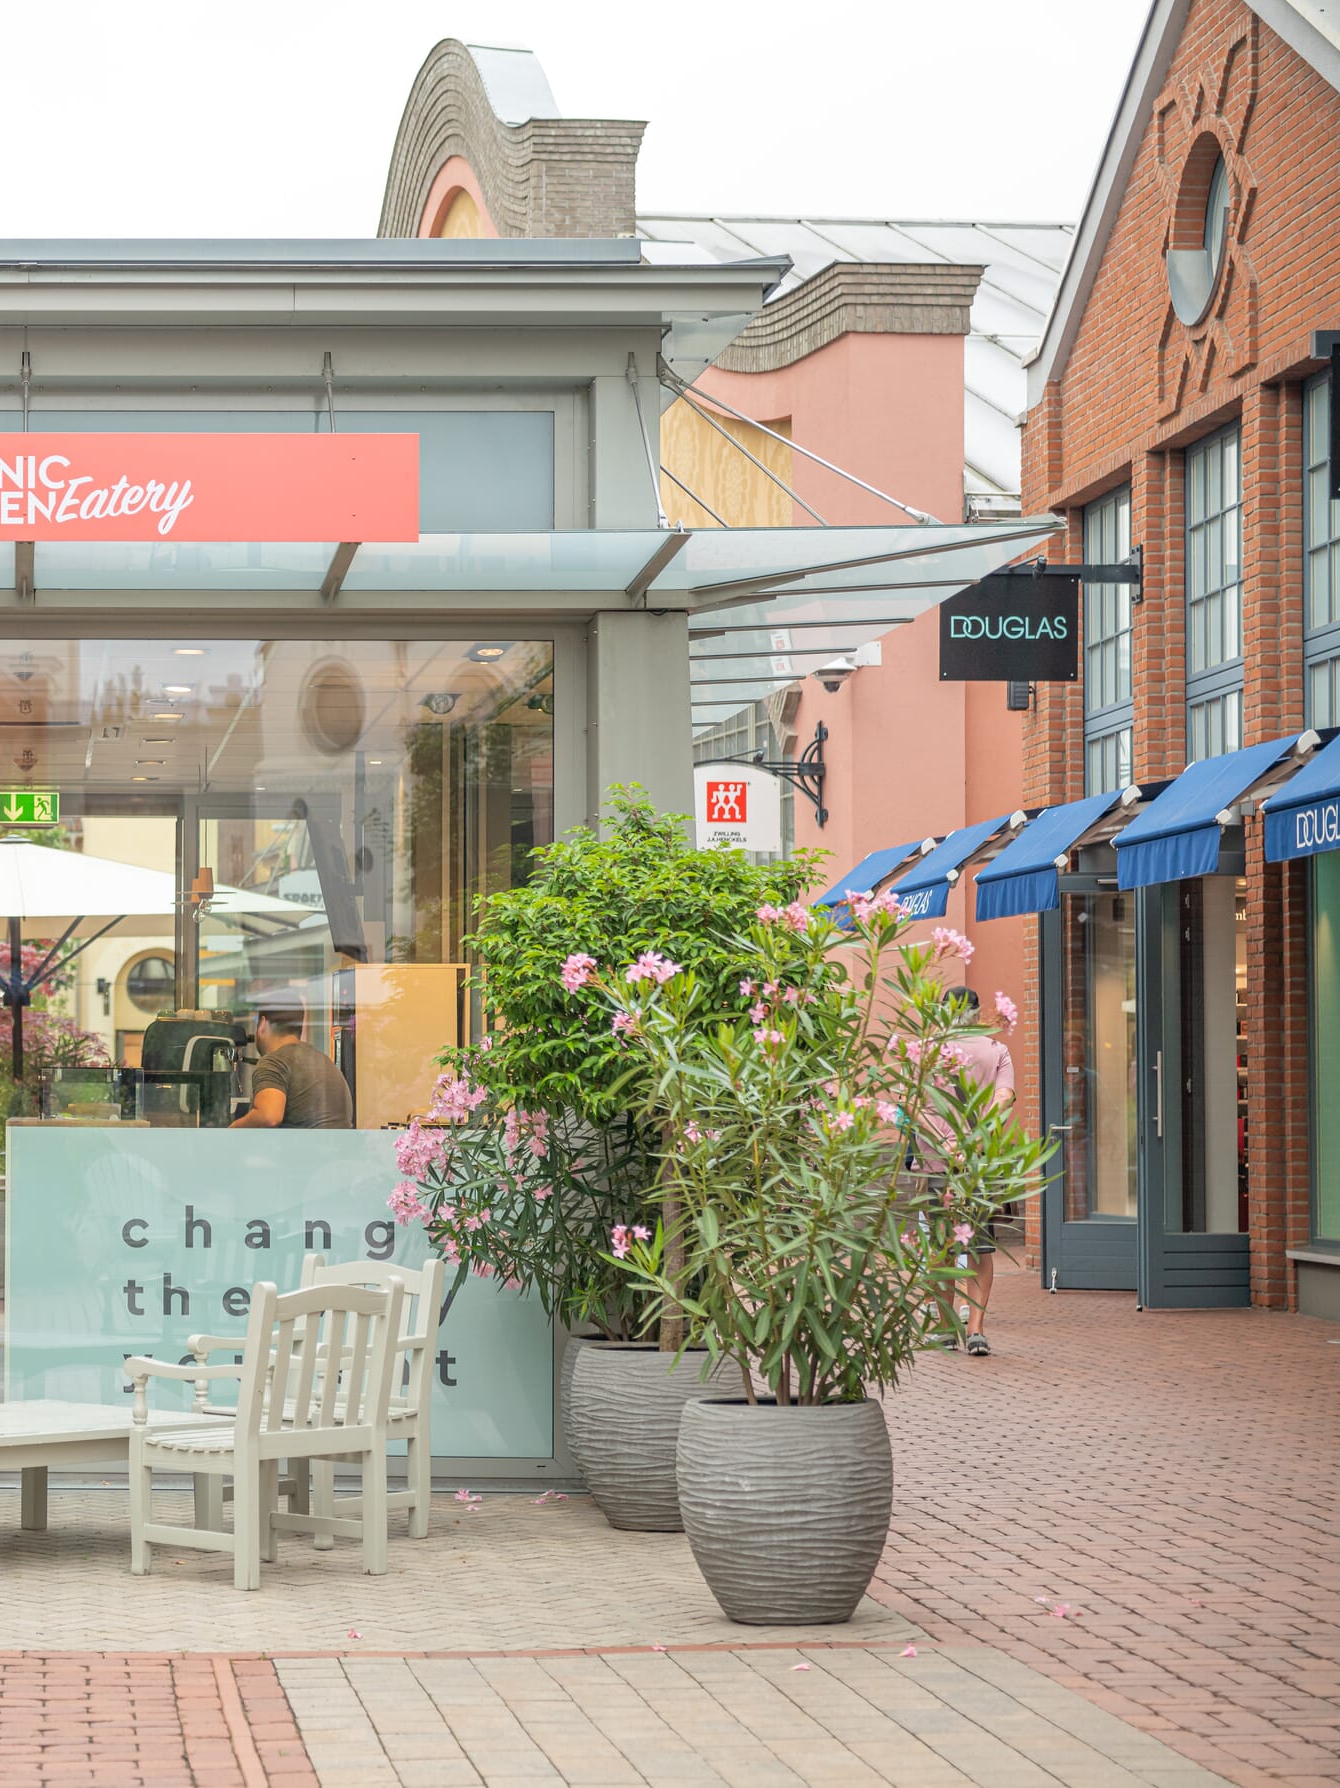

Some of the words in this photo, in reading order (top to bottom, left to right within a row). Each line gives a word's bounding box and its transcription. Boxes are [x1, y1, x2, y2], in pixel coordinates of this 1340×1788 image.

[57, 475, 195, 535] Eatery
[950, 615, 1068, 639] DOUGLAS
[123, 1272, 251, 1317] the
